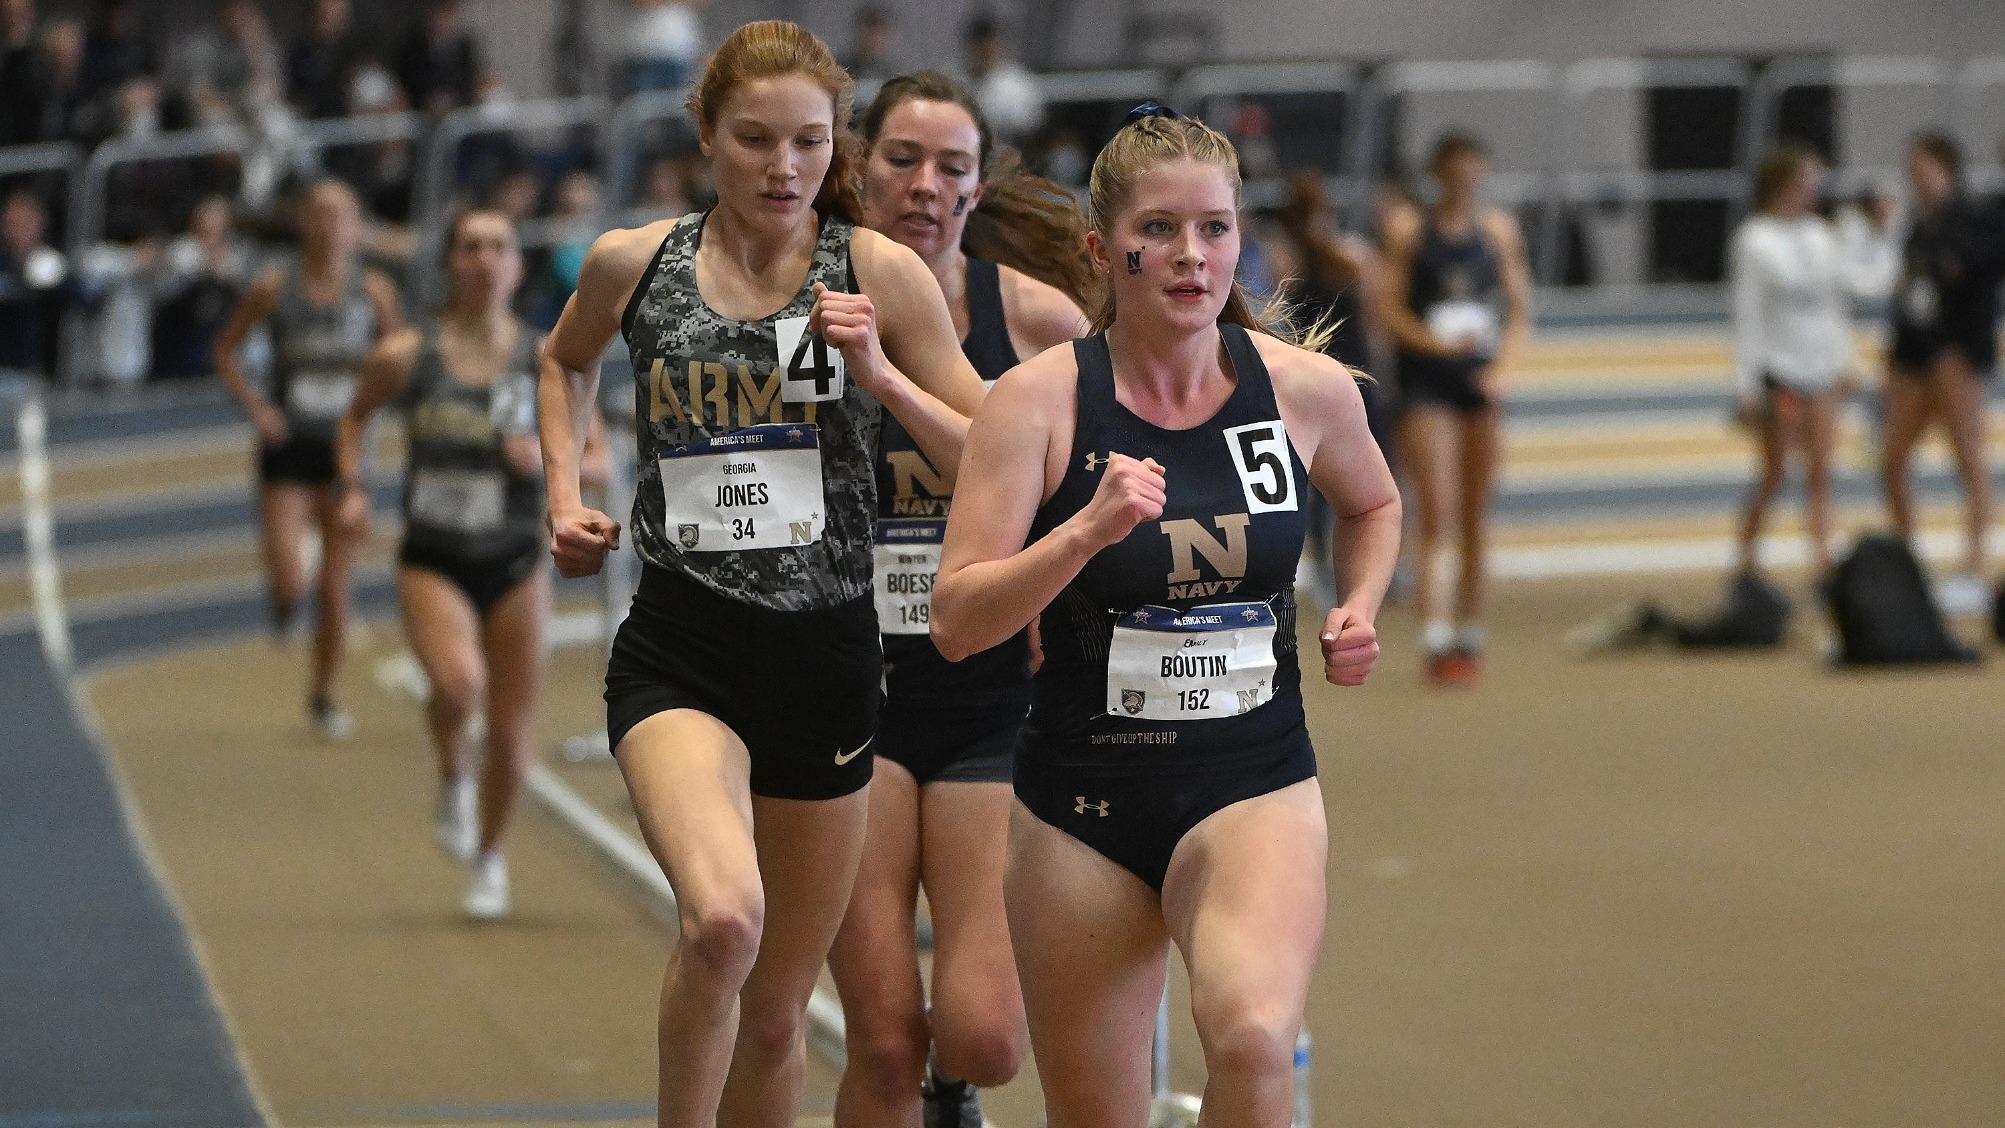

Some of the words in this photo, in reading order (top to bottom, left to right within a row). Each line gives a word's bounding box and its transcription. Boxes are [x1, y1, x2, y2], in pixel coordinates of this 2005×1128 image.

[787, 322, 836, 396] 4
[710, 435, 745, 447] AMERICA'S
[745, 434, 764, 444] MEET
[723, 463, 757, 475] GEORGIA
[886, 450, 954, 499] N
[1236, 427, 1288, 505] 5
[715, 482, 769, 507] JONES
[732, 518, 756, 540] 34
[789, 521, 812, 545] N
[1160, 513, 1251, 583] N
[1168, 580, 1243, 600] NAVY
[899, 603, 930, 625] 149
[1205, 615, 1223, 624] MEET
[1160, 655, 1227, 678] BOUTIN
[1177, 688, 1210, 711] 152
[1236, 688, 1259, 713] N
[1138, 732, 1154, 744] THE
[1155, 731, 1178, 744] SHIP
